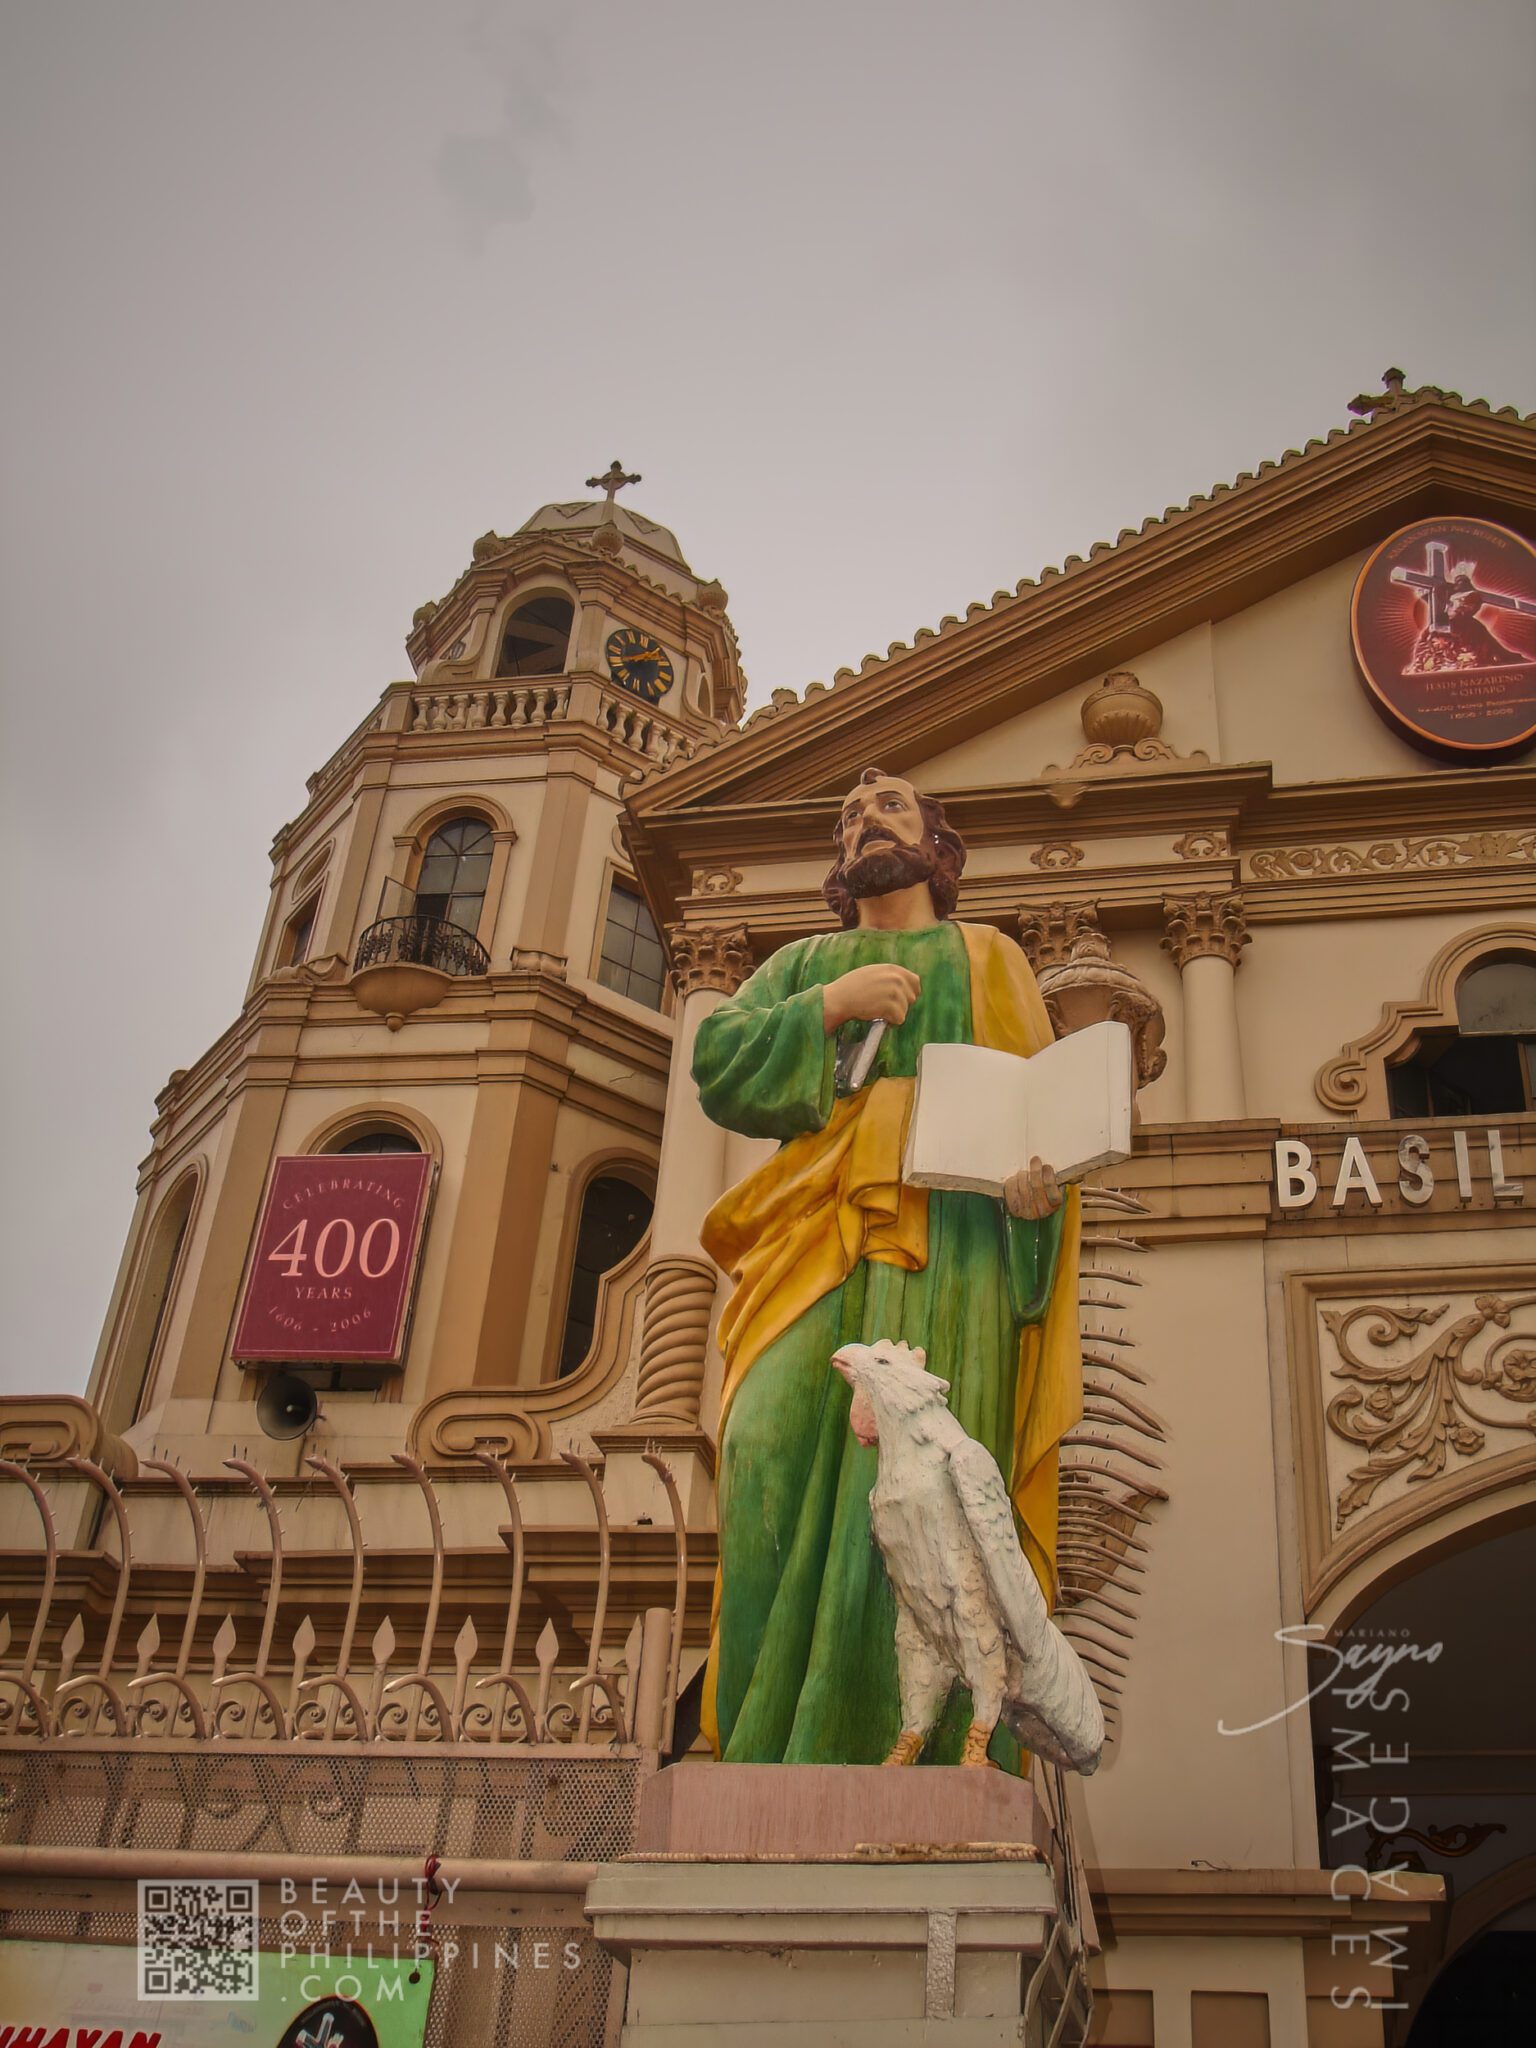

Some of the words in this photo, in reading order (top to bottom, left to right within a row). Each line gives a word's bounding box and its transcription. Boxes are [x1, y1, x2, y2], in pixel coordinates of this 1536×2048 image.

[1274, 1129, 1525, 1211] BASIL
[283, 1178, 405, 1209] CELEBRATING
[267, 1217, 400, 1279] 400
[295, 1286, 353, 1299] YEARS
[268, 1305, 302, 1332] 1606
[330, 1308, 373, 1332] 2006
